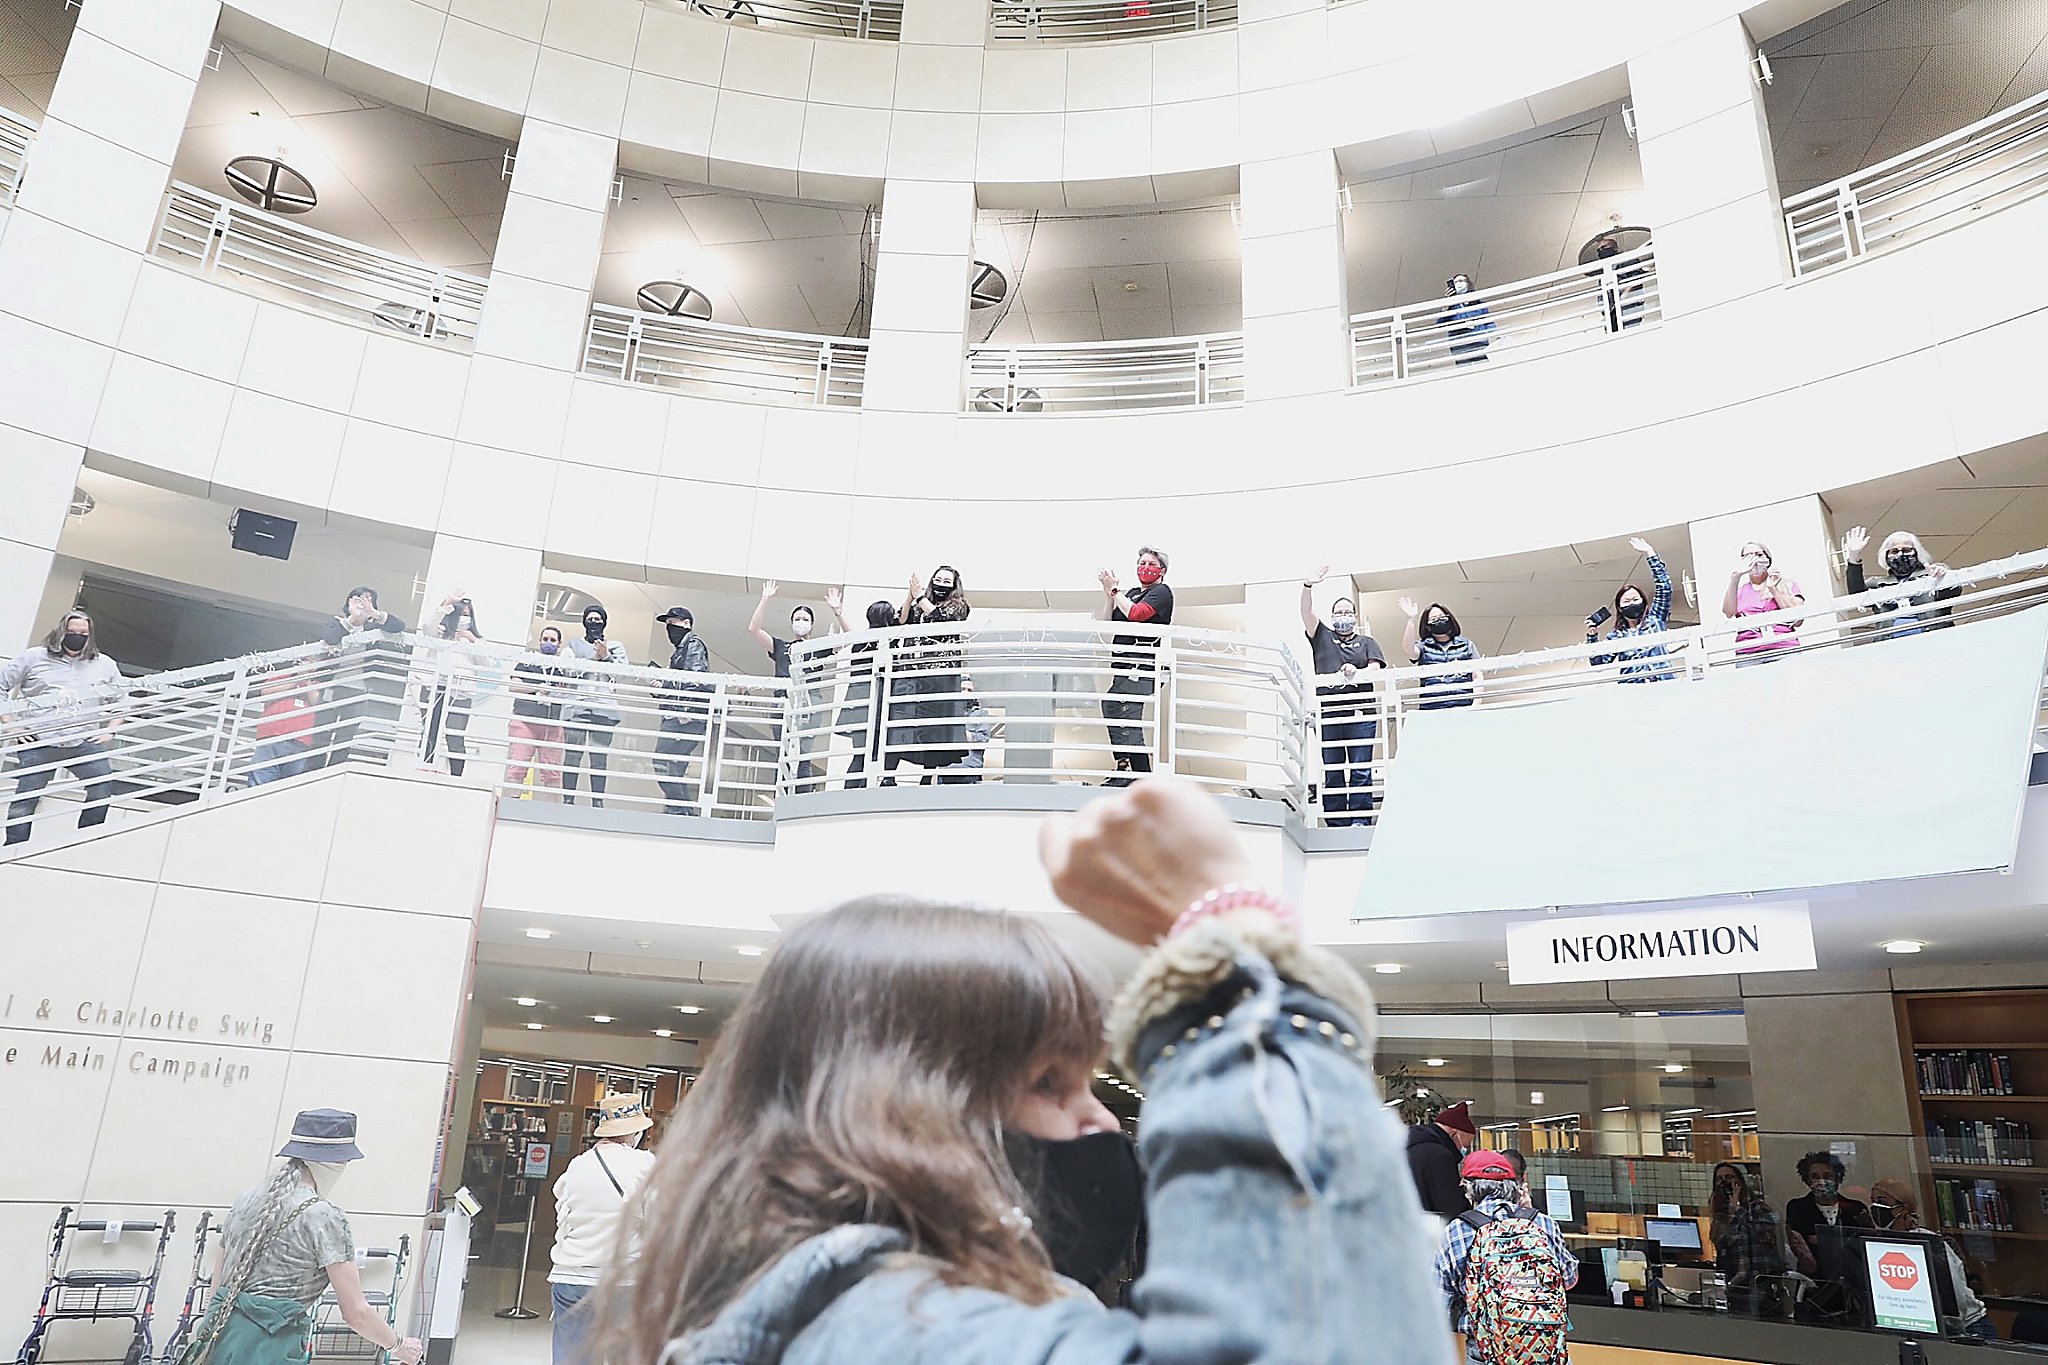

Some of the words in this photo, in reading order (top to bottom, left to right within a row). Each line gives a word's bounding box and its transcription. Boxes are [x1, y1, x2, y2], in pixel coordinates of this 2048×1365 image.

[1552, 925, 1760, 964] INFORMATION
[36, 998, 52, 1021] &
[77, 1001, 199, 1032] Charlotte
[219, 1014, 274, 1044] Swig
[40, 1045, 105, 1071] Main
[129, 1051, 250, 1087] Campaign
[1880, 1264, 1916, 1278] STOP
